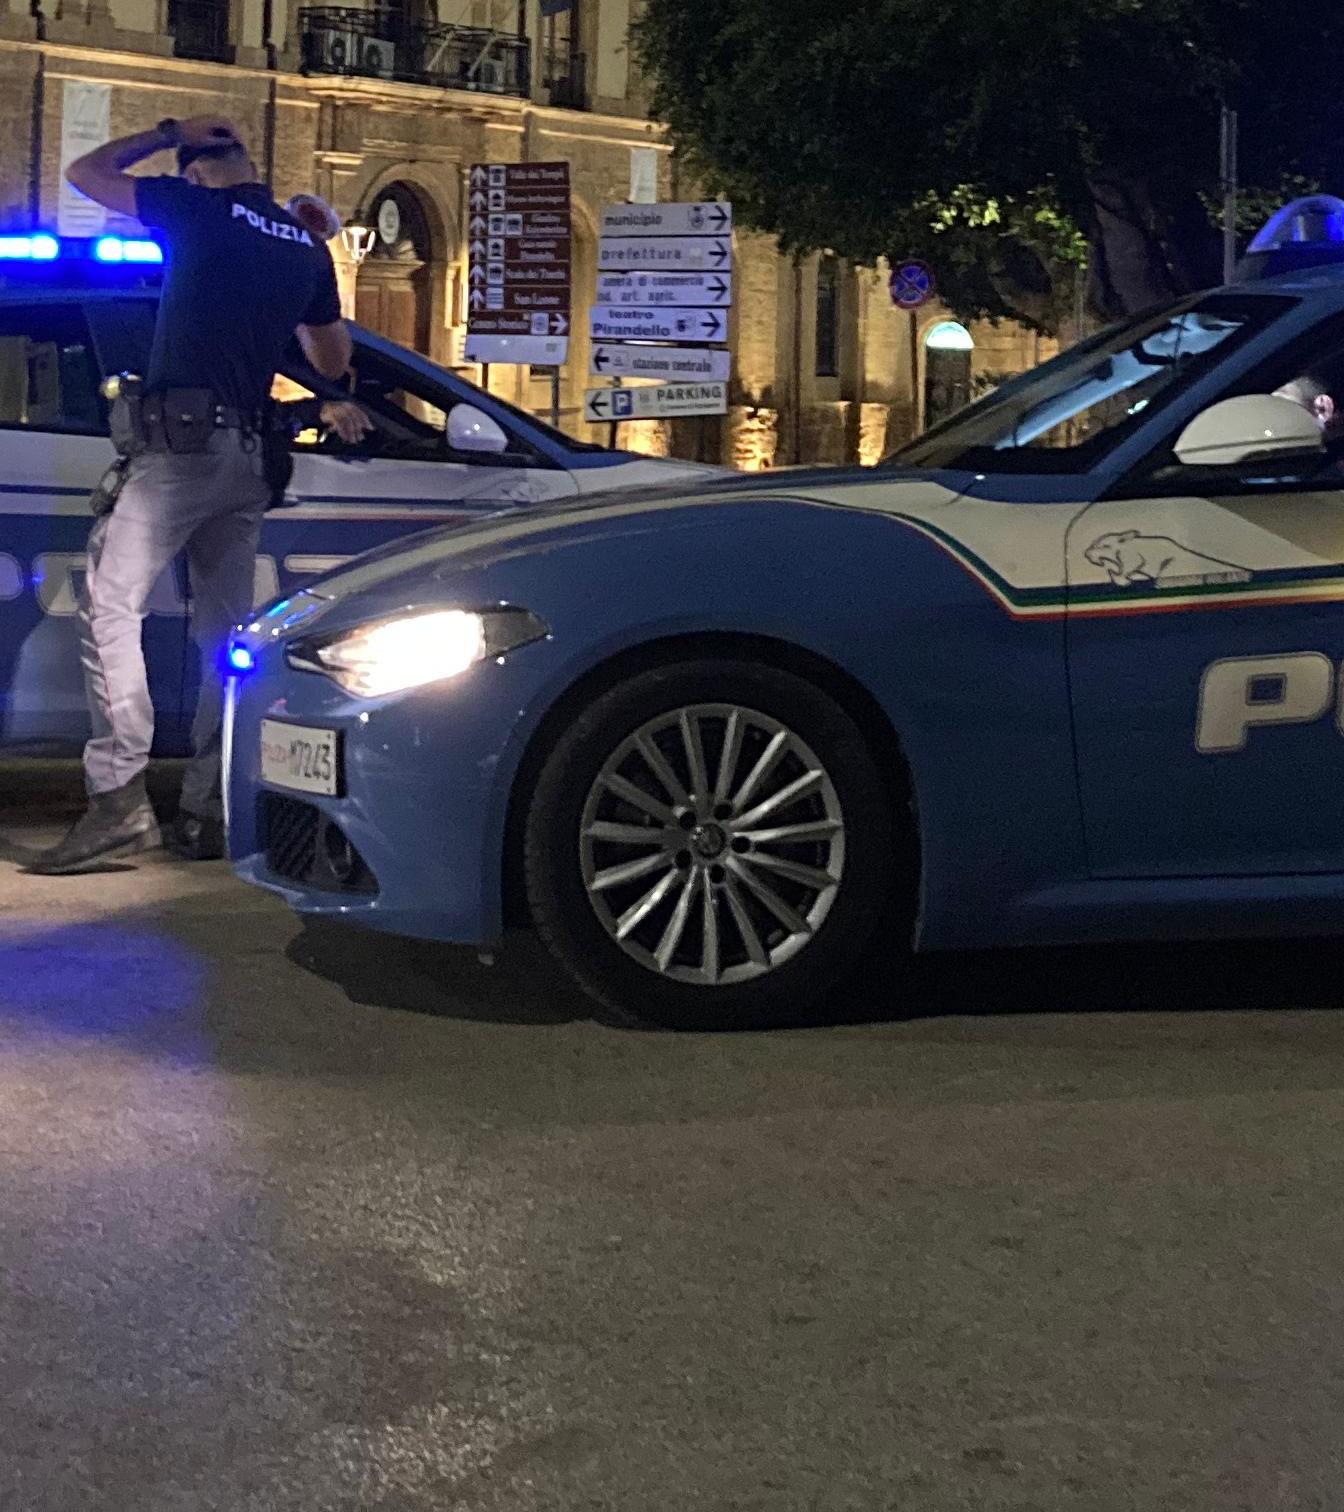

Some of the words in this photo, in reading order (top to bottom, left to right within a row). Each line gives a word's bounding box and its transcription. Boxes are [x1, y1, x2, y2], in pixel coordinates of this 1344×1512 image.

[232, 203, 314, 247] POLIZIA
[605, 212, 663, 227] municipio
[601, 248, 682, 262] prefettura
[608, 310, 655, 320] teatro
[593, 323, 671, 337] Pirandello
[657, 385, 722, 401] PARKING
